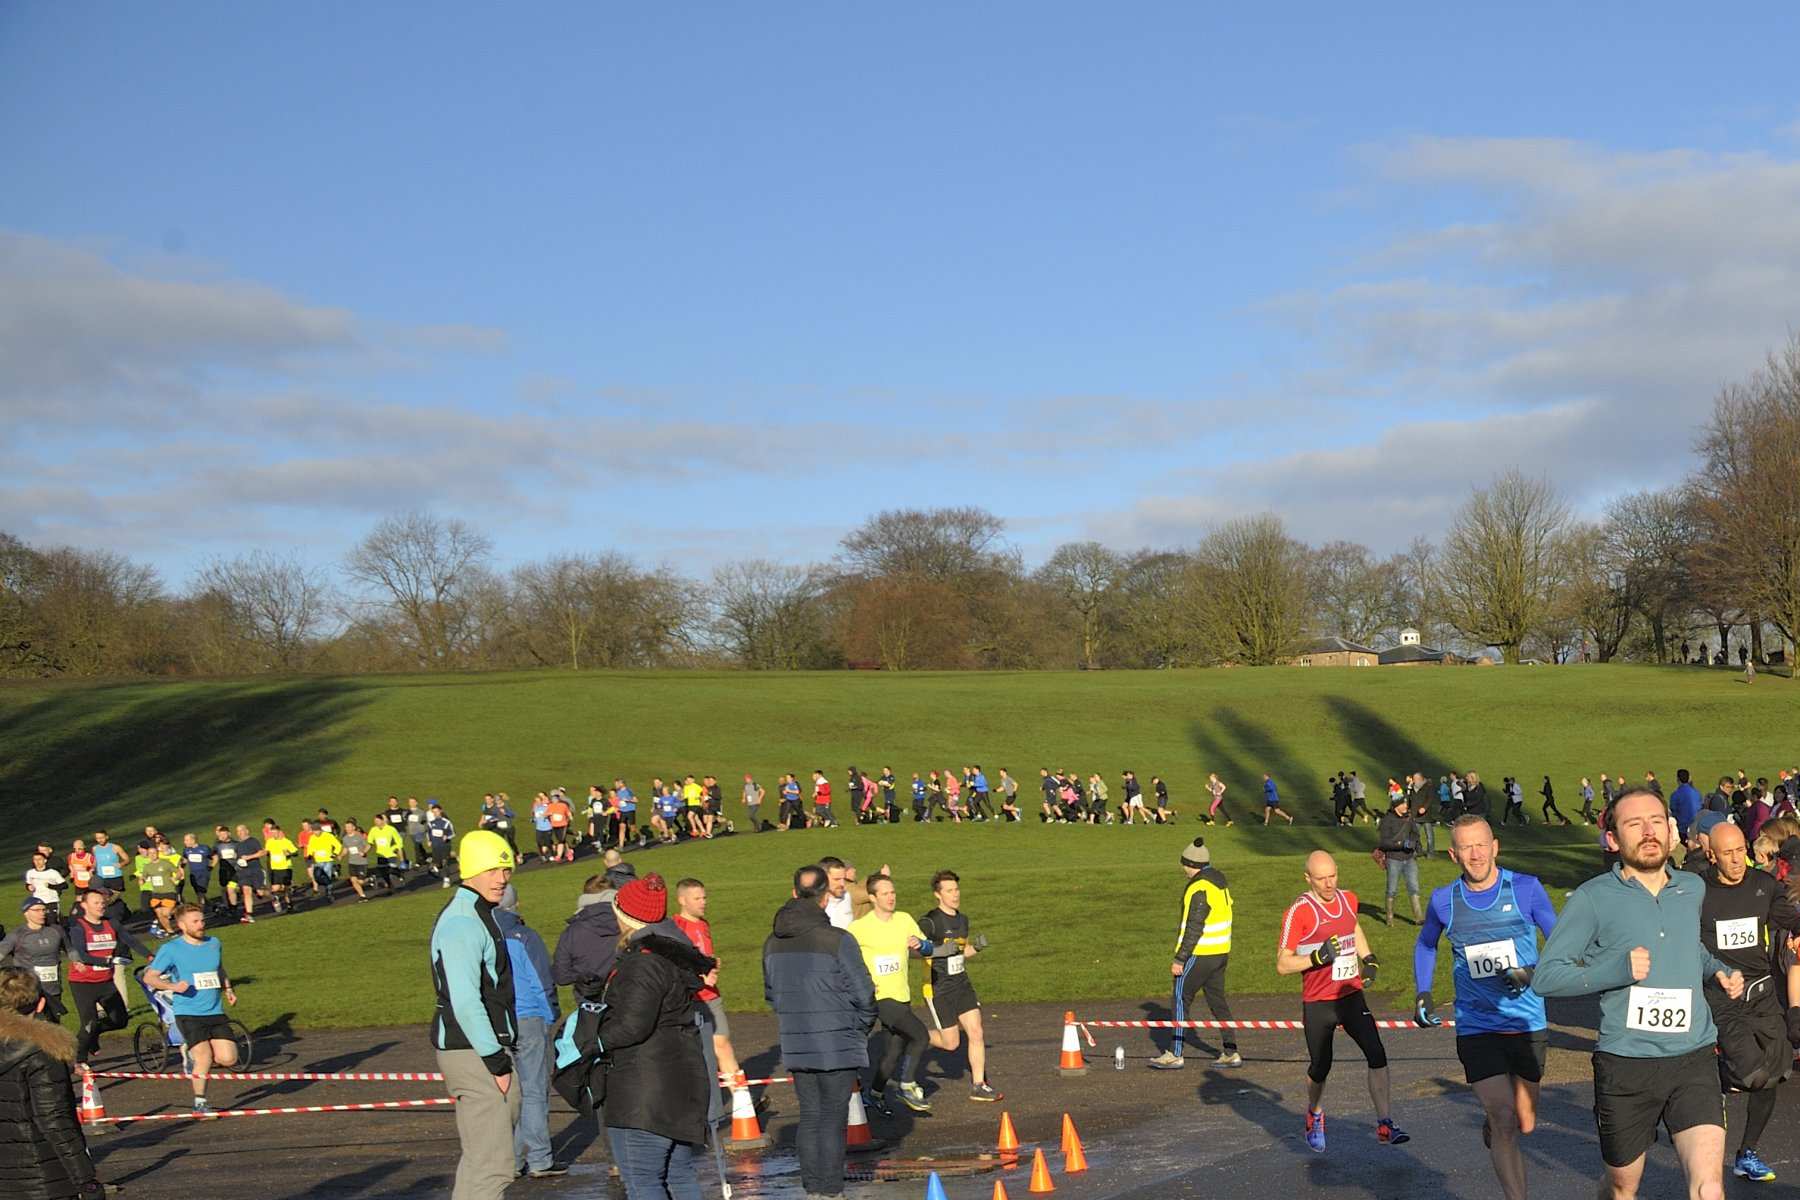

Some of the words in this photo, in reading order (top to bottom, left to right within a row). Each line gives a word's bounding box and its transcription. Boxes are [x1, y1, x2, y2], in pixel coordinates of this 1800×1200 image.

[1723, 930, 1755, 946] 1256
[878, 962, 900, 973] 1763
[1473, 955, 1512, 975] 1051
[1637, 1006, 1686, 1027] 1382
